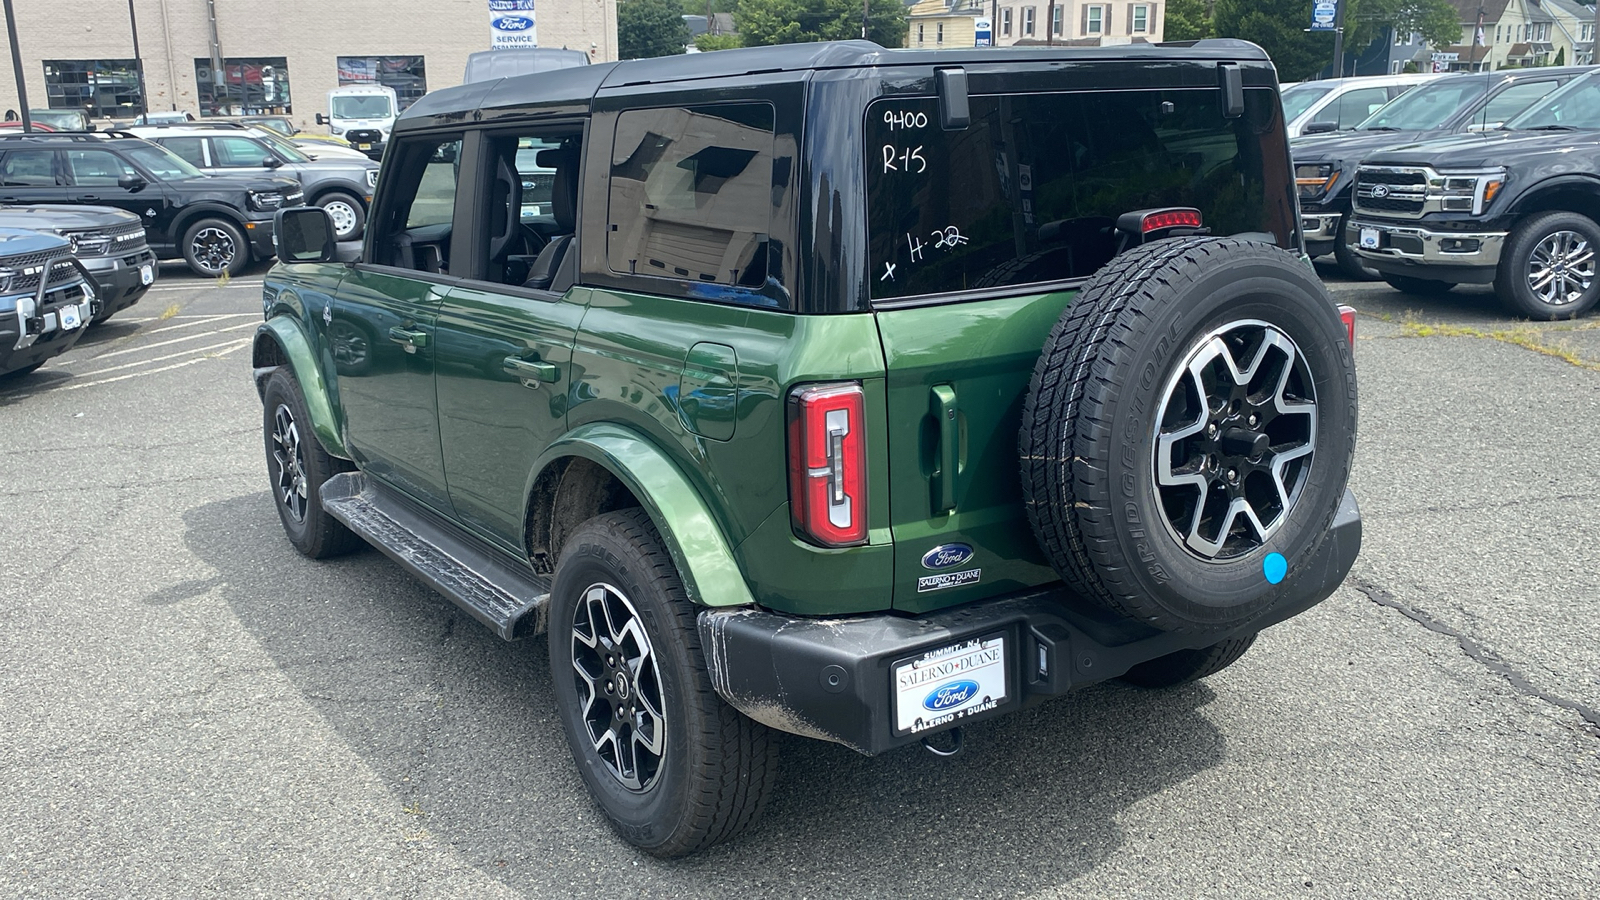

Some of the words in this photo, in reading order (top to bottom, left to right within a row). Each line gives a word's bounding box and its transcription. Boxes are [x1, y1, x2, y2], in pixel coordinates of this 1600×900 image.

[500, 17, 527, 30] Ford
[496, 35, 533, 43] SERVICE
[883, 110, 928, 131] 9400
[882, 144, 927, 174] R-15
[935, 548, 963, 566] Ford
[920, 575, 950, 587] SALERNO
[956, 570, 979, 581] DUANE
[899, 660, 954, 688] SALERNO
[960, 648, 1000, 671] DUANE
[933, 684, 968, 709] Ford
[910, 713, 954, 734] SALERNO
[967, 700, 998, 716] DUANE
